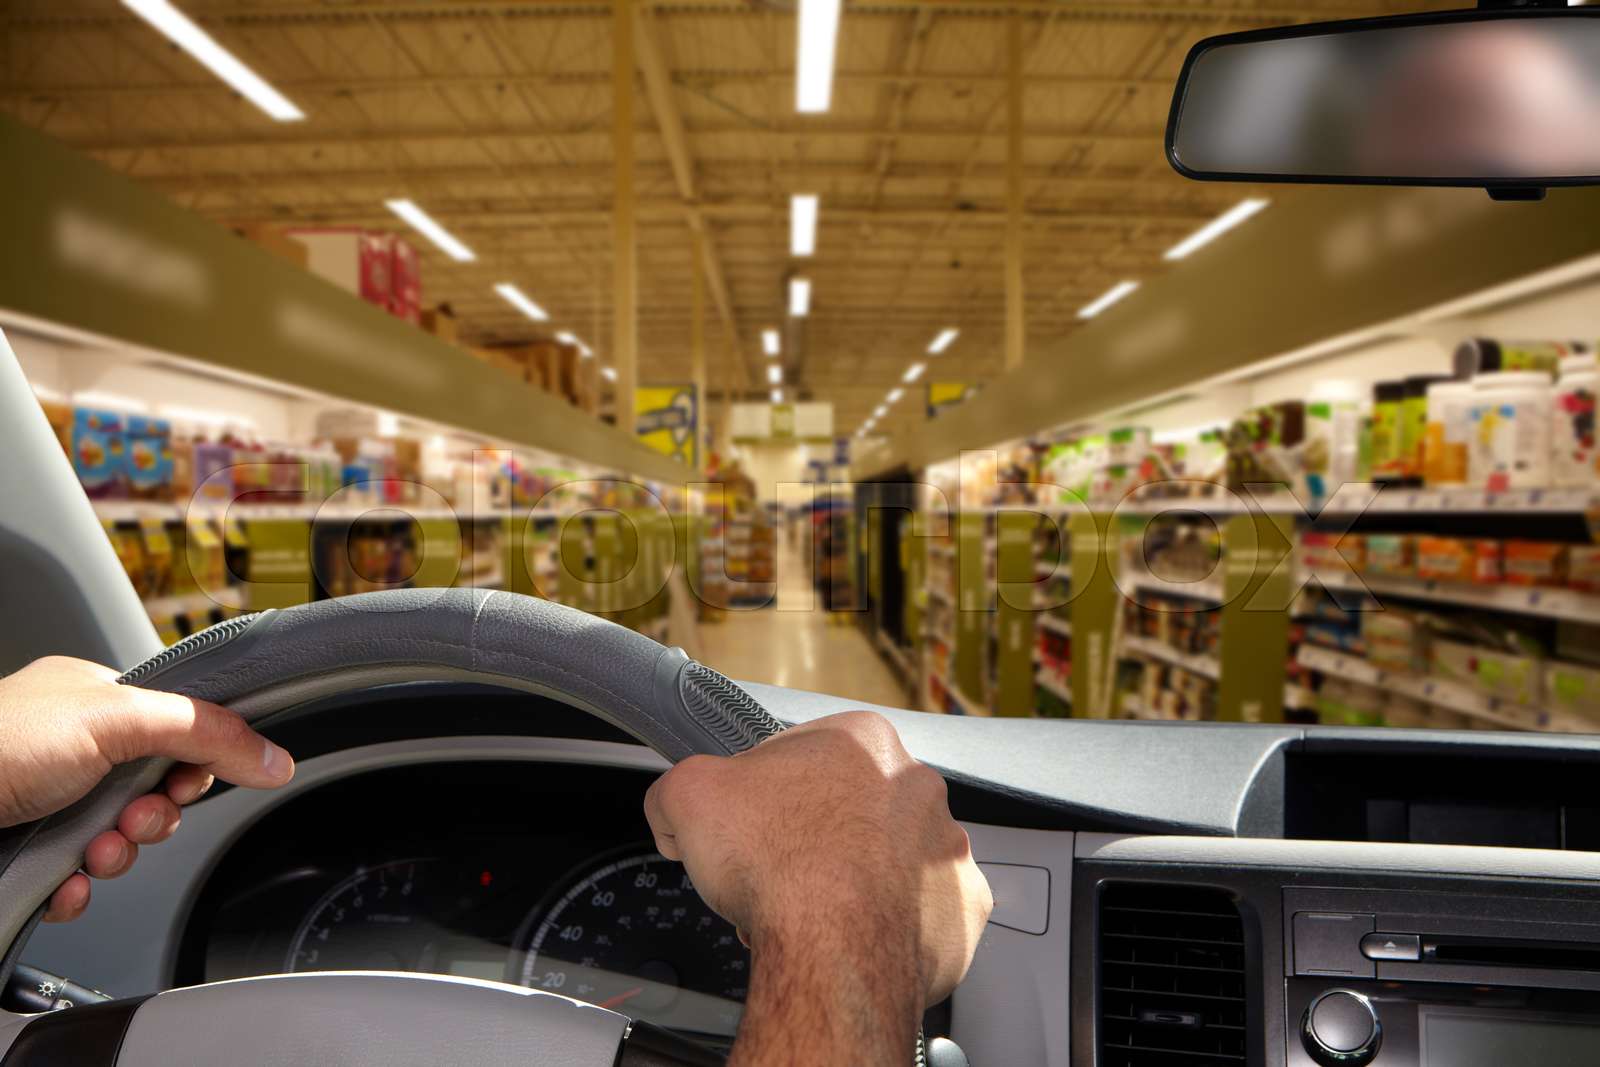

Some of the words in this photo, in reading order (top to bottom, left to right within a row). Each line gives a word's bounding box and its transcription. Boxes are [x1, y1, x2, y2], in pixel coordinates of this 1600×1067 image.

[633, 872, 658, 889] 80
[591, 891, 616, 907] 60
[335, 907, 346, 923] 5
[317, 928, 330, 942] 4
[558, 925, 584, 942] 40
[541, 972, 567, 989] 20
